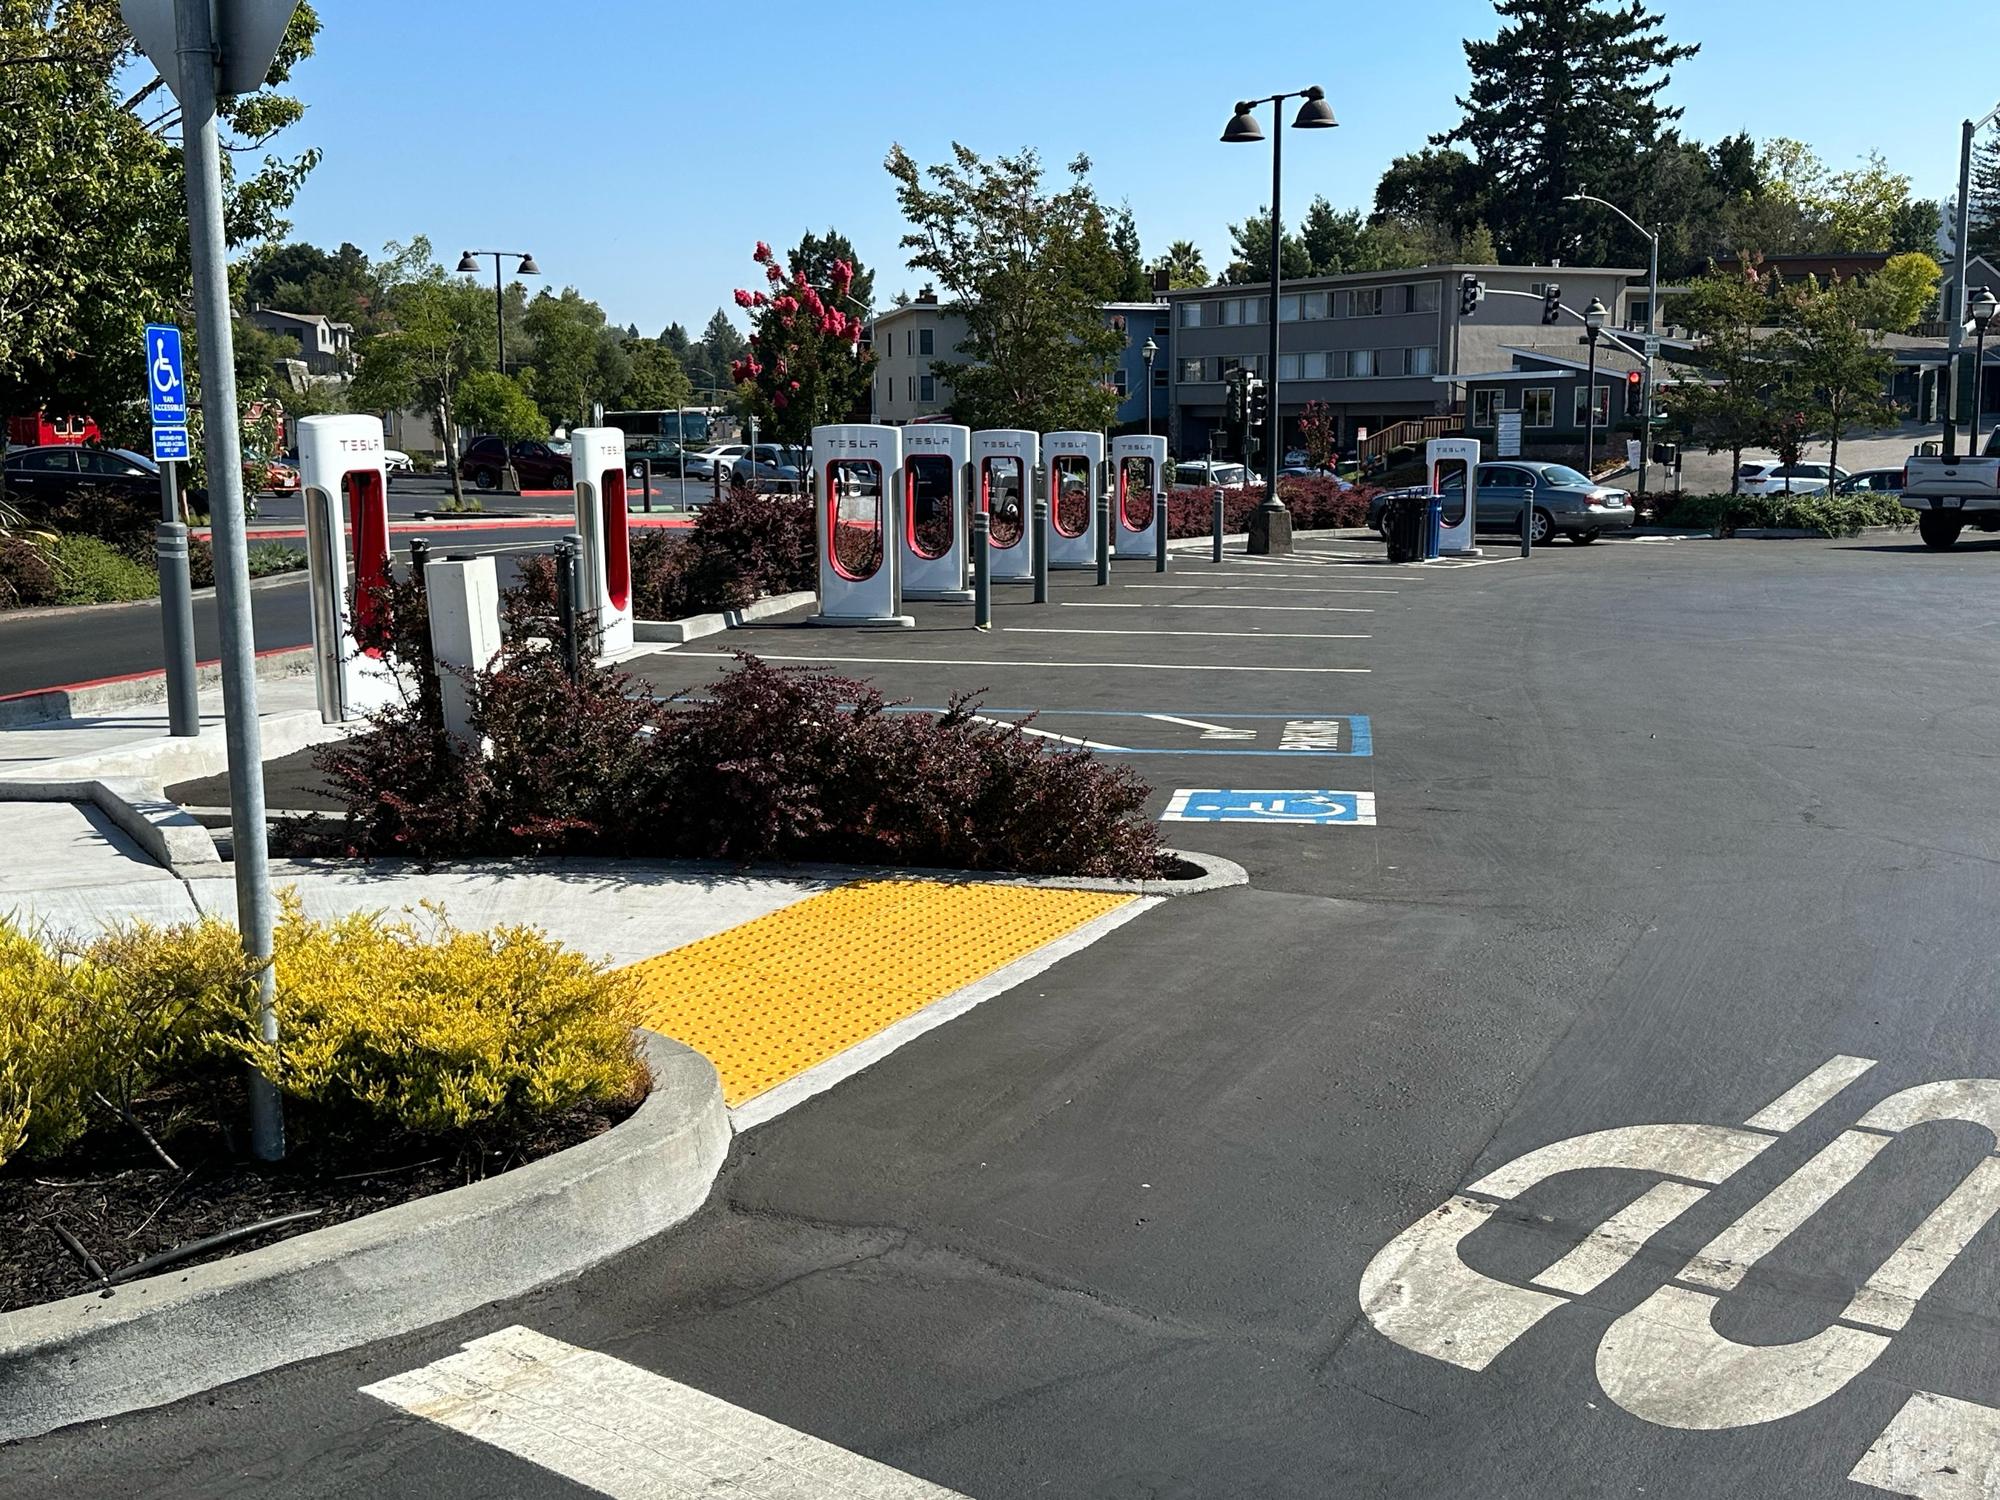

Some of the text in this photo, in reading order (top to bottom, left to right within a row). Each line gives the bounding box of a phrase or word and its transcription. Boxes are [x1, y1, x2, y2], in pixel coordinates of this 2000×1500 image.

[162, 395, 174, 403] VAN
[154, 403, 183, 412] ACCESSIBLE
[828, 440, 878, 448] TESLA
[907, 437, 950, 445] TESLA
[339, 439, 380, 452] TESLA
